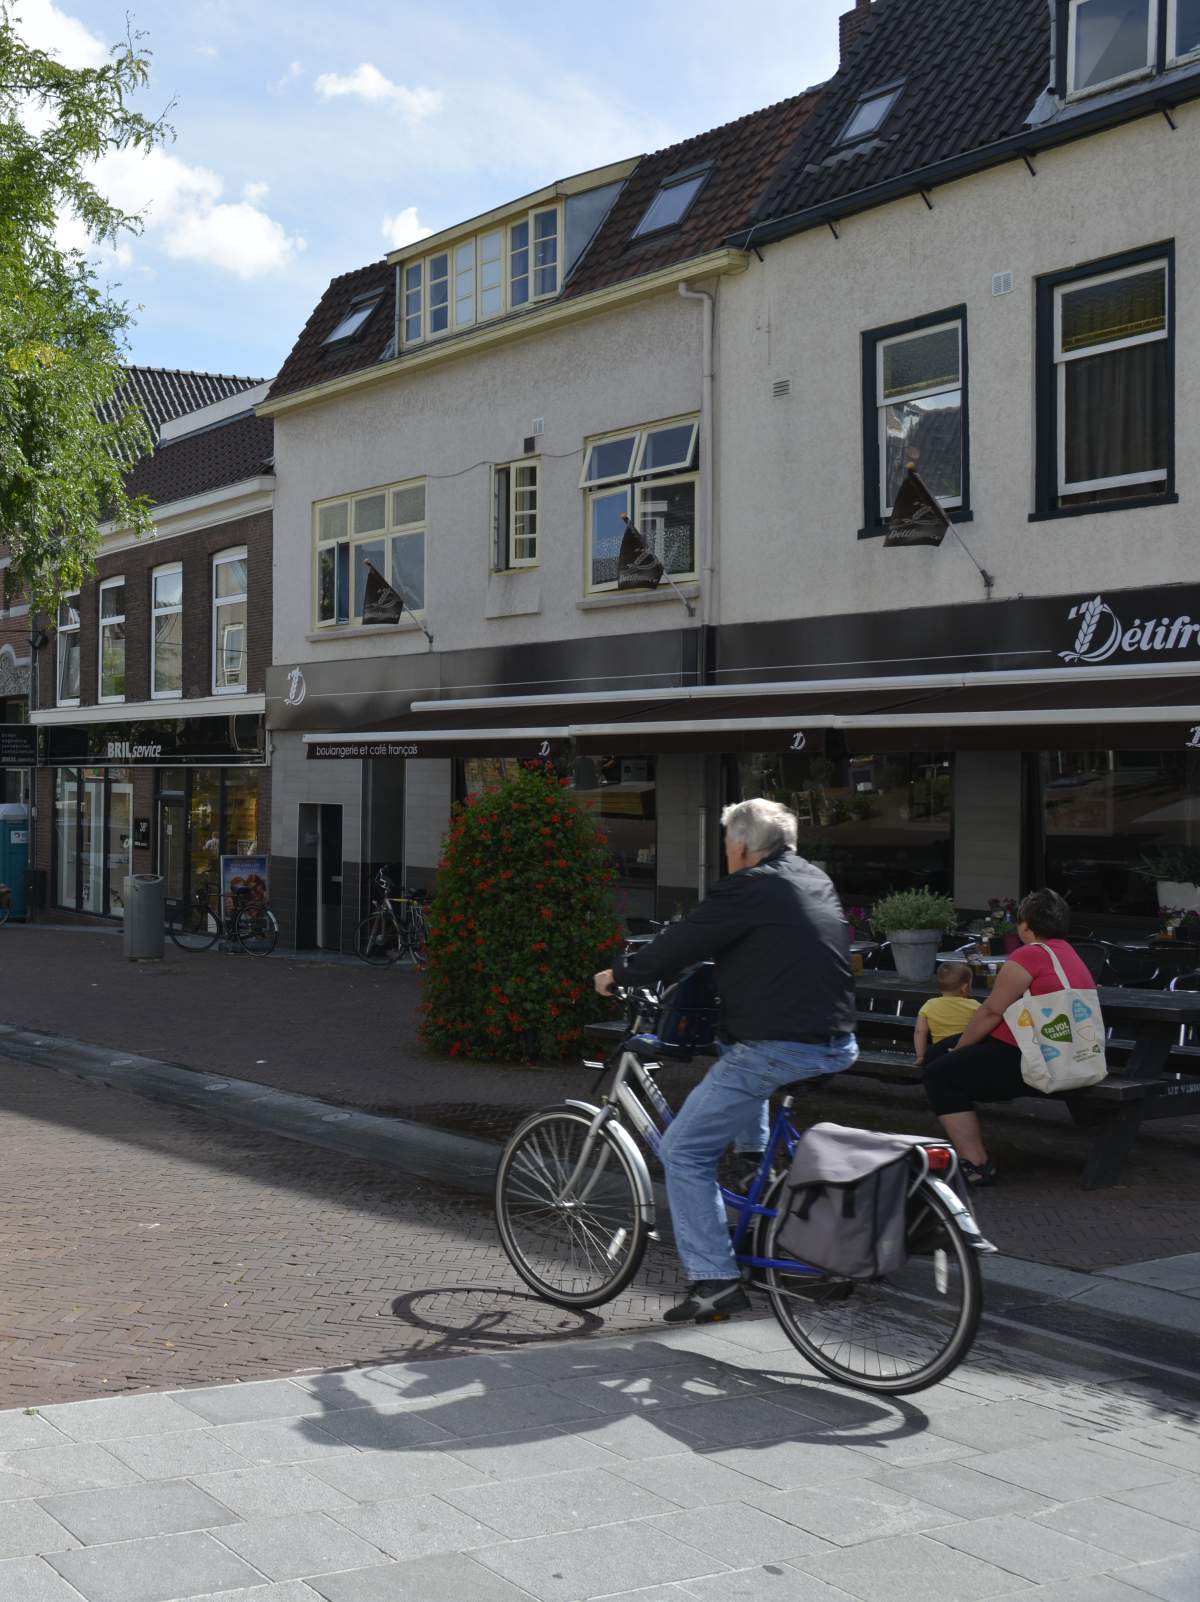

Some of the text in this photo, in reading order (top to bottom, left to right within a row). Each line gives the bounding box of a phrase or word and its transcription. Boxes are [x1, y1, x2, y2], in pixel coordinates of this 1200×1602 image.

[1057, 595, 1200, 662] Délifr
[107, 740, 162, 758] BRIL service
[316, 743, 419, 758] boulangerie et café français
